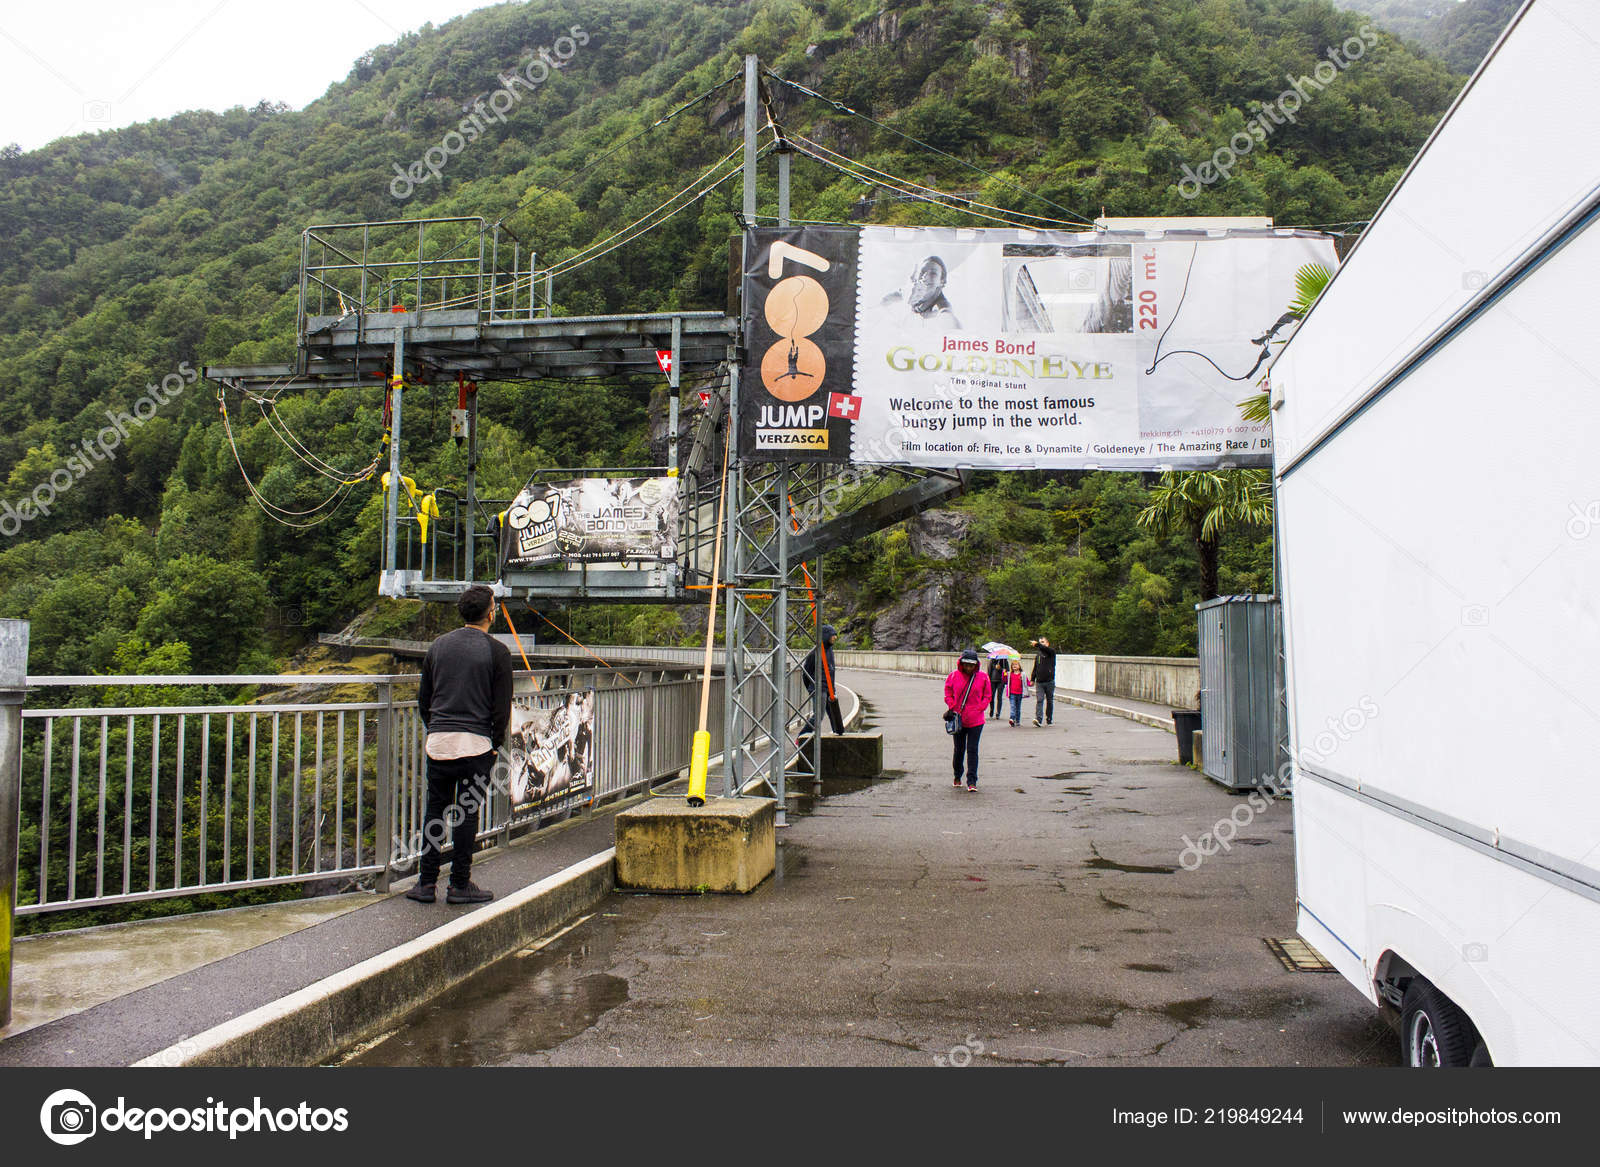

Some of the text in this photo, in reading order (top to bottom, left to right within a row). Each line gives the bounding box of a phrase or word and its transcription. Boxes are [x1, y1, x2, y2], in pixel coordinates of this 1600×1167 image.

[1139, 247, 1157, 330] 220 mt.
[942, 336, 1036, 355] James Bond
[951, 377, 1027, 390] The original stunt
[889, 396, 1095, 411] Welcome to the most famous
[756, 405, 824, 428] JUMP
[902, 412, 1082, 431] bungy jump in the world.
[758, 433, 826, 445] VERZASCA
[901, 441, 921, 451] Film
[925, 441, 963, 452] location
[967, 442, 980, 453] of:
[983, 443, 1003, 454] Fire,
[1006, 445, 1020, 454] Ice
[1024, 445, 1032, 453] &
[1036, 443, 1083, 456] Dynamite
[1093, 444, 1145, 457] Goldeneye
[1157, 443, 1176, 452] The
[1179, 441, 1221, 453] Amazing
[1225, 439, 1249, 450] Race
[593, 506, 643, 520] JAMES
[586, 519, 627, 532] BOND
